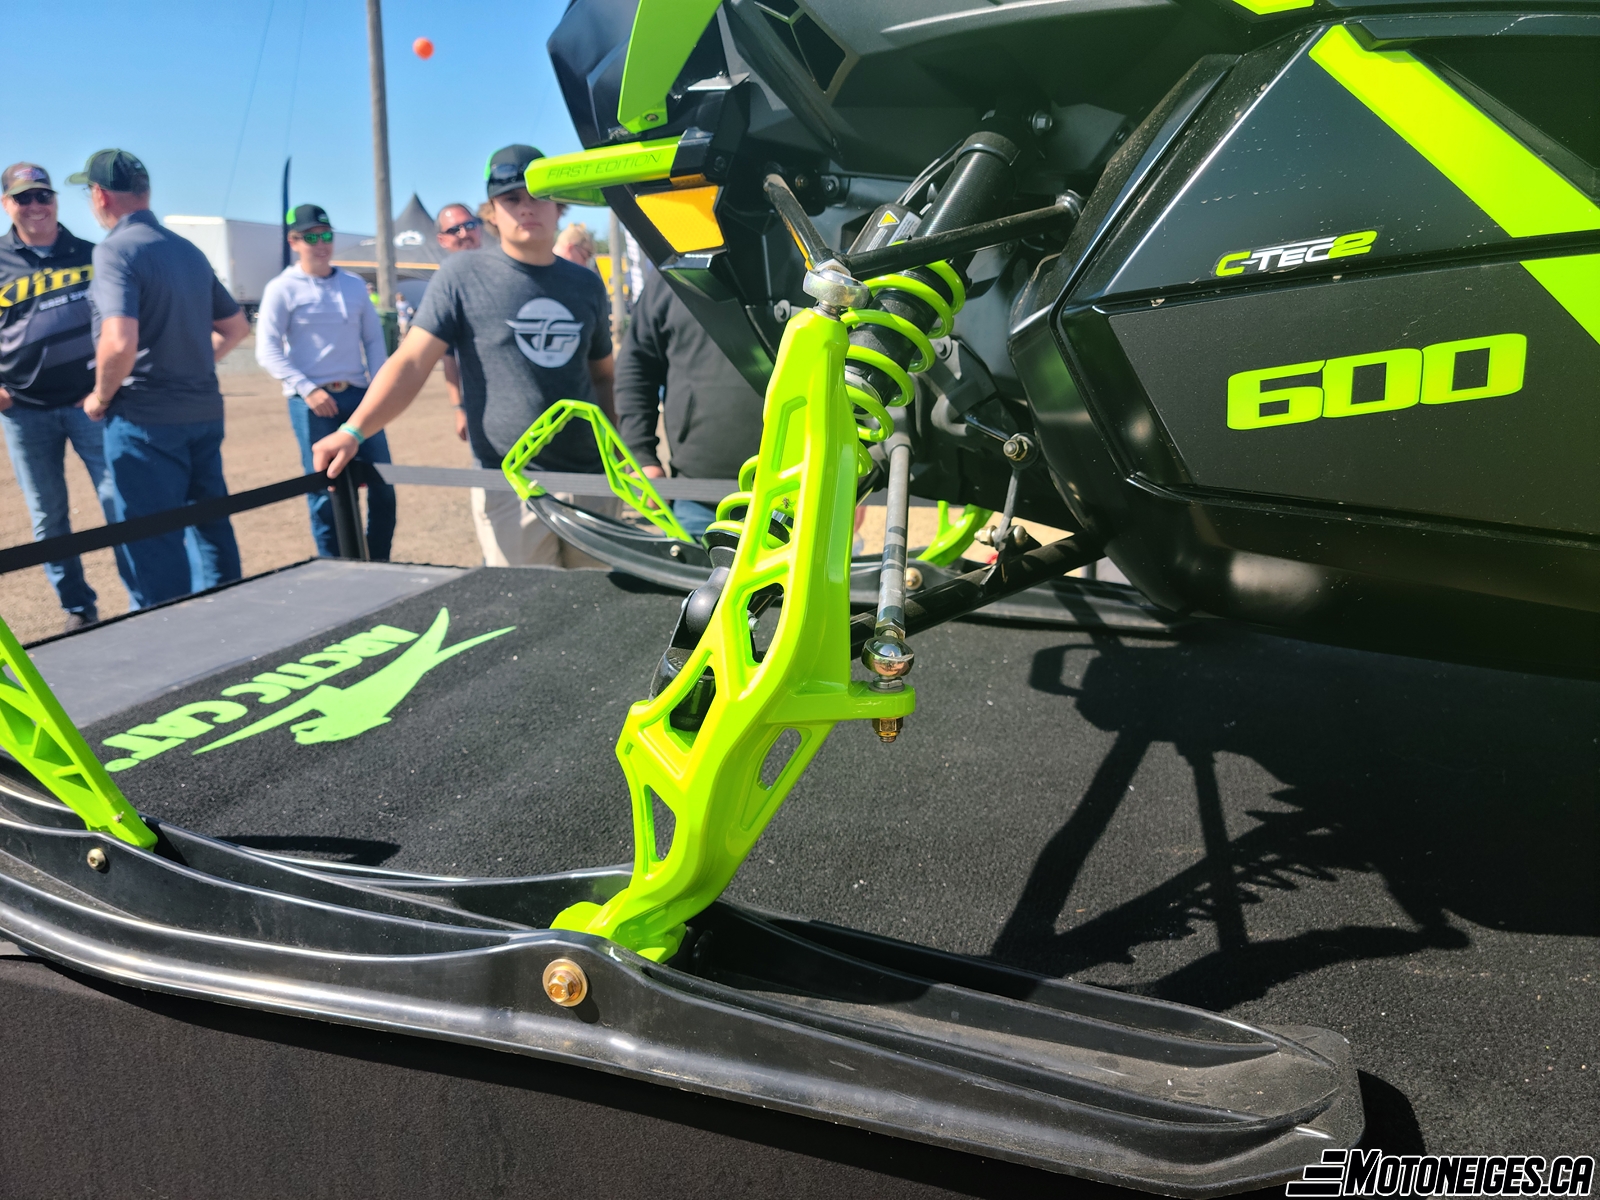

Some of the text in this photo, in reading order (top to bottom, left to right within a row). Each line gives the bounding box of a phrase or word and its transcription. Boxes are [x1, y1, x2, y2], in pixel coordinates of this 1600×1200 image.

[546, 153, 662, 180] FIRST EDITION
[1215, 230, 1378, 277] C-TEC2
[1227, 333, 1527, 430] 600
[102, 624, 419, 761] ARCTIC CAT
